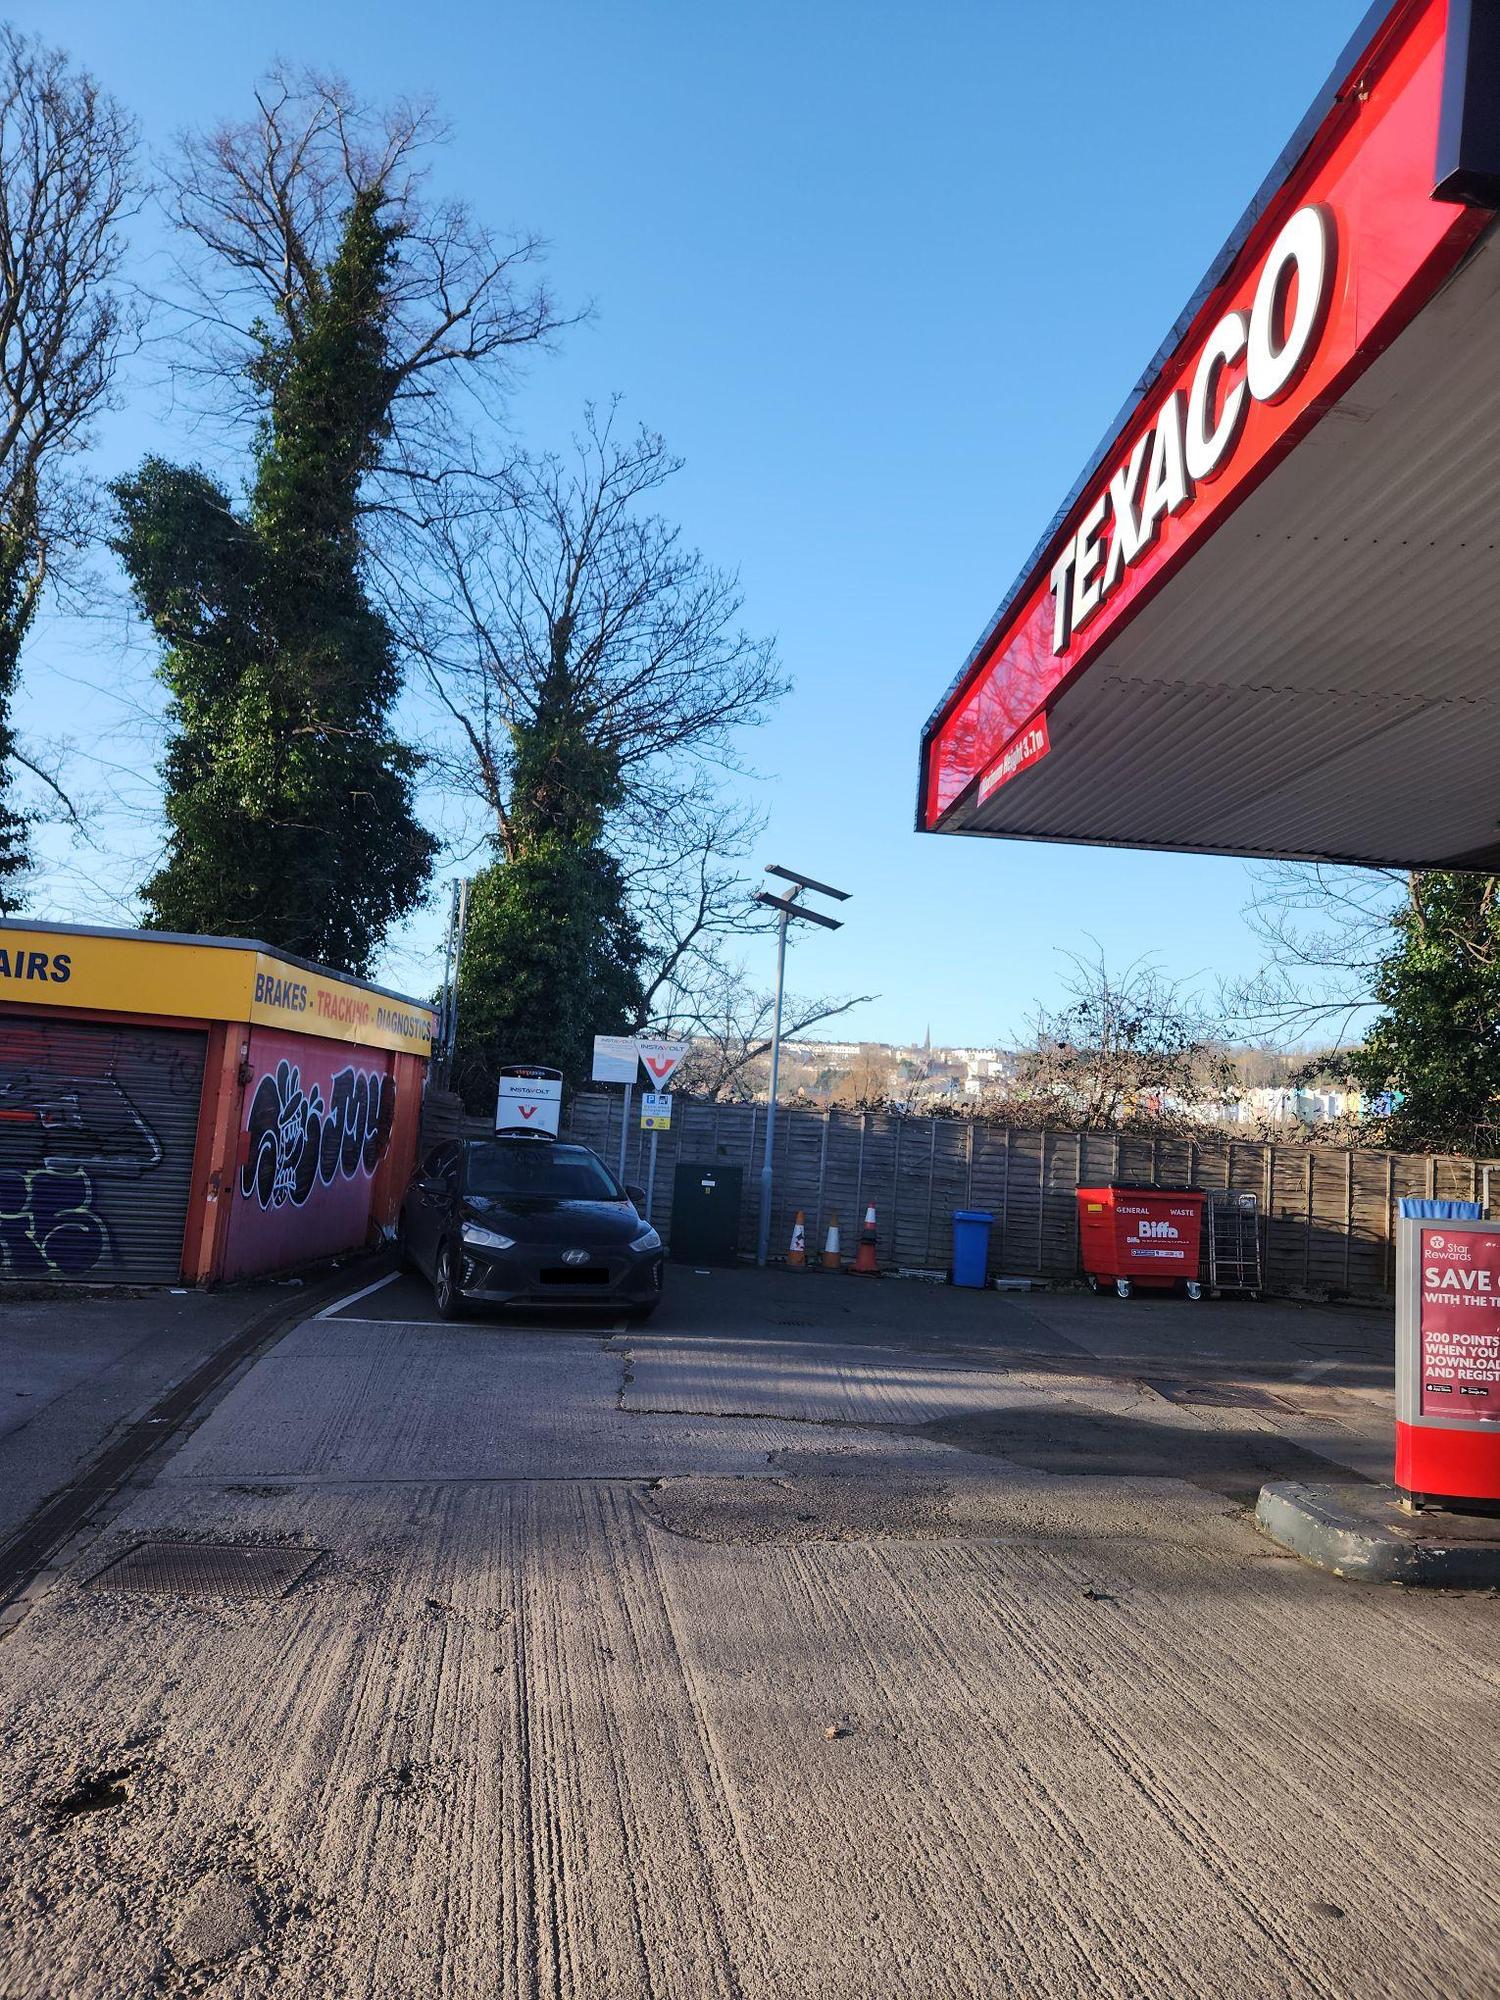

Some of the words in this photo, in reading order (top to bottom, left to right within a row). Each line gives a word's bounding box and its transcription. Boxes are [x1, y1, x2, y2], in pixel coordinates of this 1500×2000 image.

[1050, 203, 1335, 657] TEXACO
[1022, 730, 1044, 759] 3.7m
[254, 973, 308, 1012] BRAKES
[317, 990, 370, 1026] TRACKING
[376, 1007, 432, 1042] DIAGNOSTICS
[1116, 1206, 1150, 1215] GENERAL
[1170, 1209, 1195, 1217] WASTE
[1138, 1220, 1179, 1238] Biffa
[1424, 1249, 1472, 1261] Rewards
[1447, 1243, 1469, 1254] Star
[1425, 1267, 1492, 1291] SAVE
[1424, 1292, 1461, 1305] WITH
[1463, 1295, 1488, 1307] THE
[1424, 1331, 1450, 1343] 200
[1452, 1333, 1500, 1347] POINTS
[1425, 1343, 1467, 1356] WHEN
[1468, 1346, 1499, 1358] YOU
[1425, 1366, 1455, 1378] AND
[1457, 1369, 1500, 1382] REGIST
